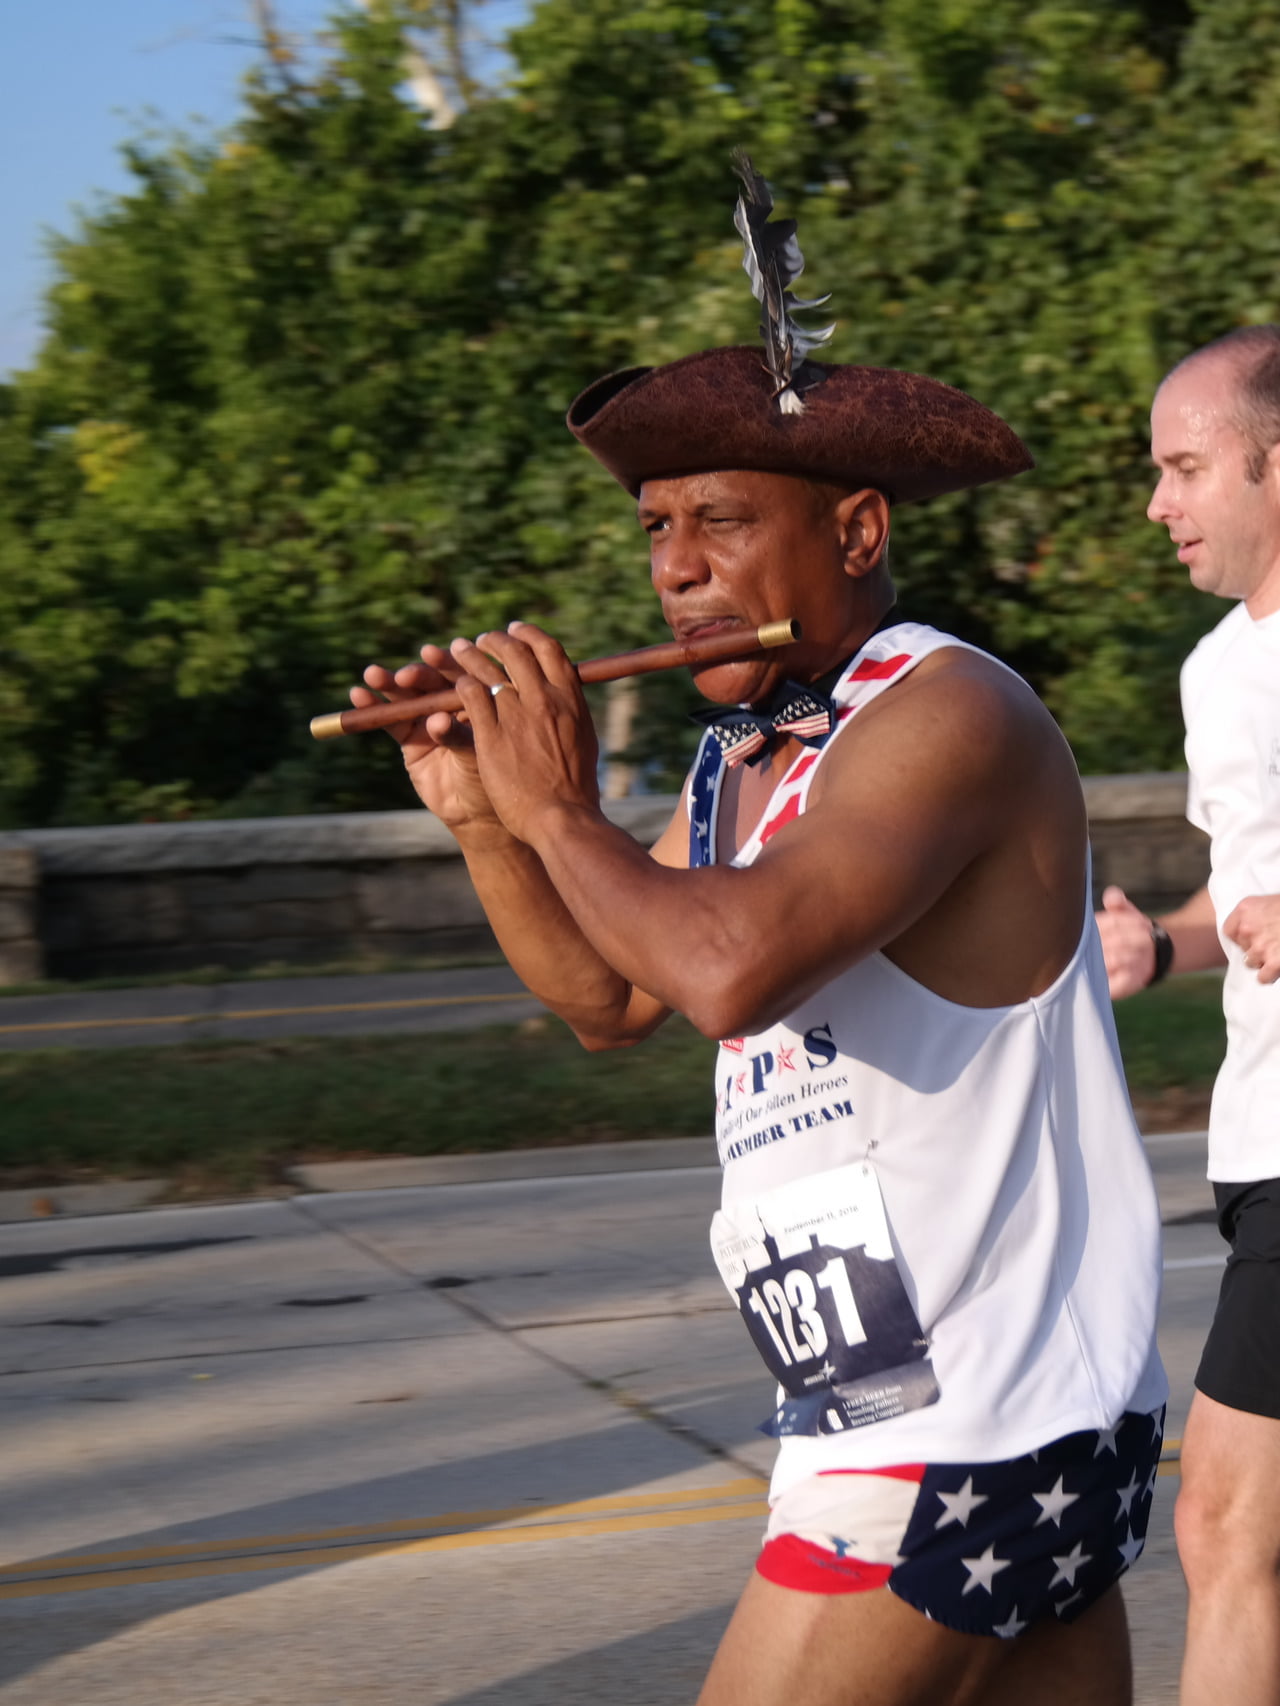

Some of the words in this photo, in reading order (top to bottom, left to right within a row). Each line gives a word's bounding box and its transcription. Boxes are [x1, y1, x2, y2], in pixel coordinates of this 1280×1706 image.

[800, 1074, 849, 1099] Heroes
[788, 1099, 855, 1133] TEAM
[748, 1256, 868, 1367] 1231
